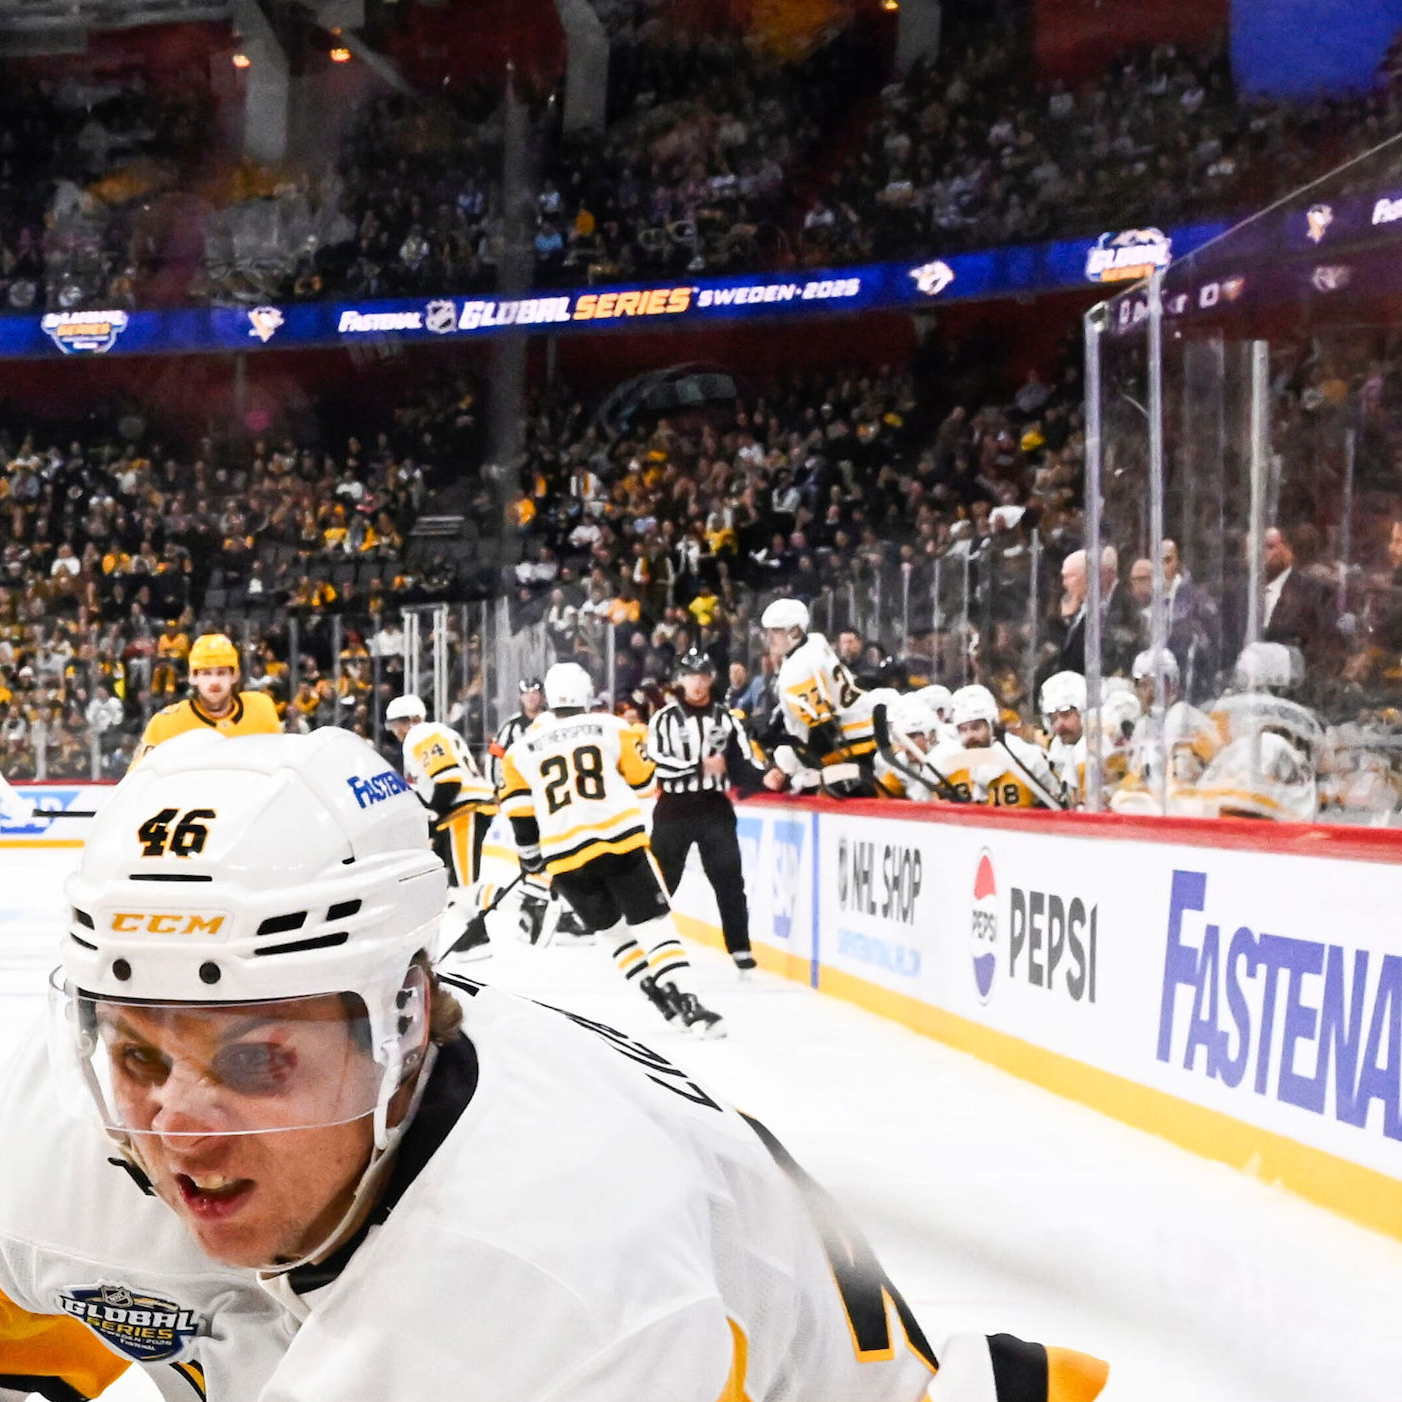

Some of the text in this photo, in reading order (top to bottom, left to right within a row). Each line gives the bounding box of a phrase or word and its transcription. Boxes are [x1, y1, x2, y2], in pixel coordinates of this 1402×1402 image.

[458, 297, 570, 329] GLOBAL
[573, 285, 693, 321] SERIES
[540, 744, 606, 816] 28
[137, 807, 219, 858] 46
[852, 841, 877, 916] NHL
[882, 844, 923, 926] SHOP
[110, 912, 226, 935] CCM
[1010, 886, 1099, 1004] PEPSI
[1156, 868, 1402, 1142] FASTENA
[64, 1298, 195, 1331] GLOBAL
[87, 1316, 175, 1340] SERIES
